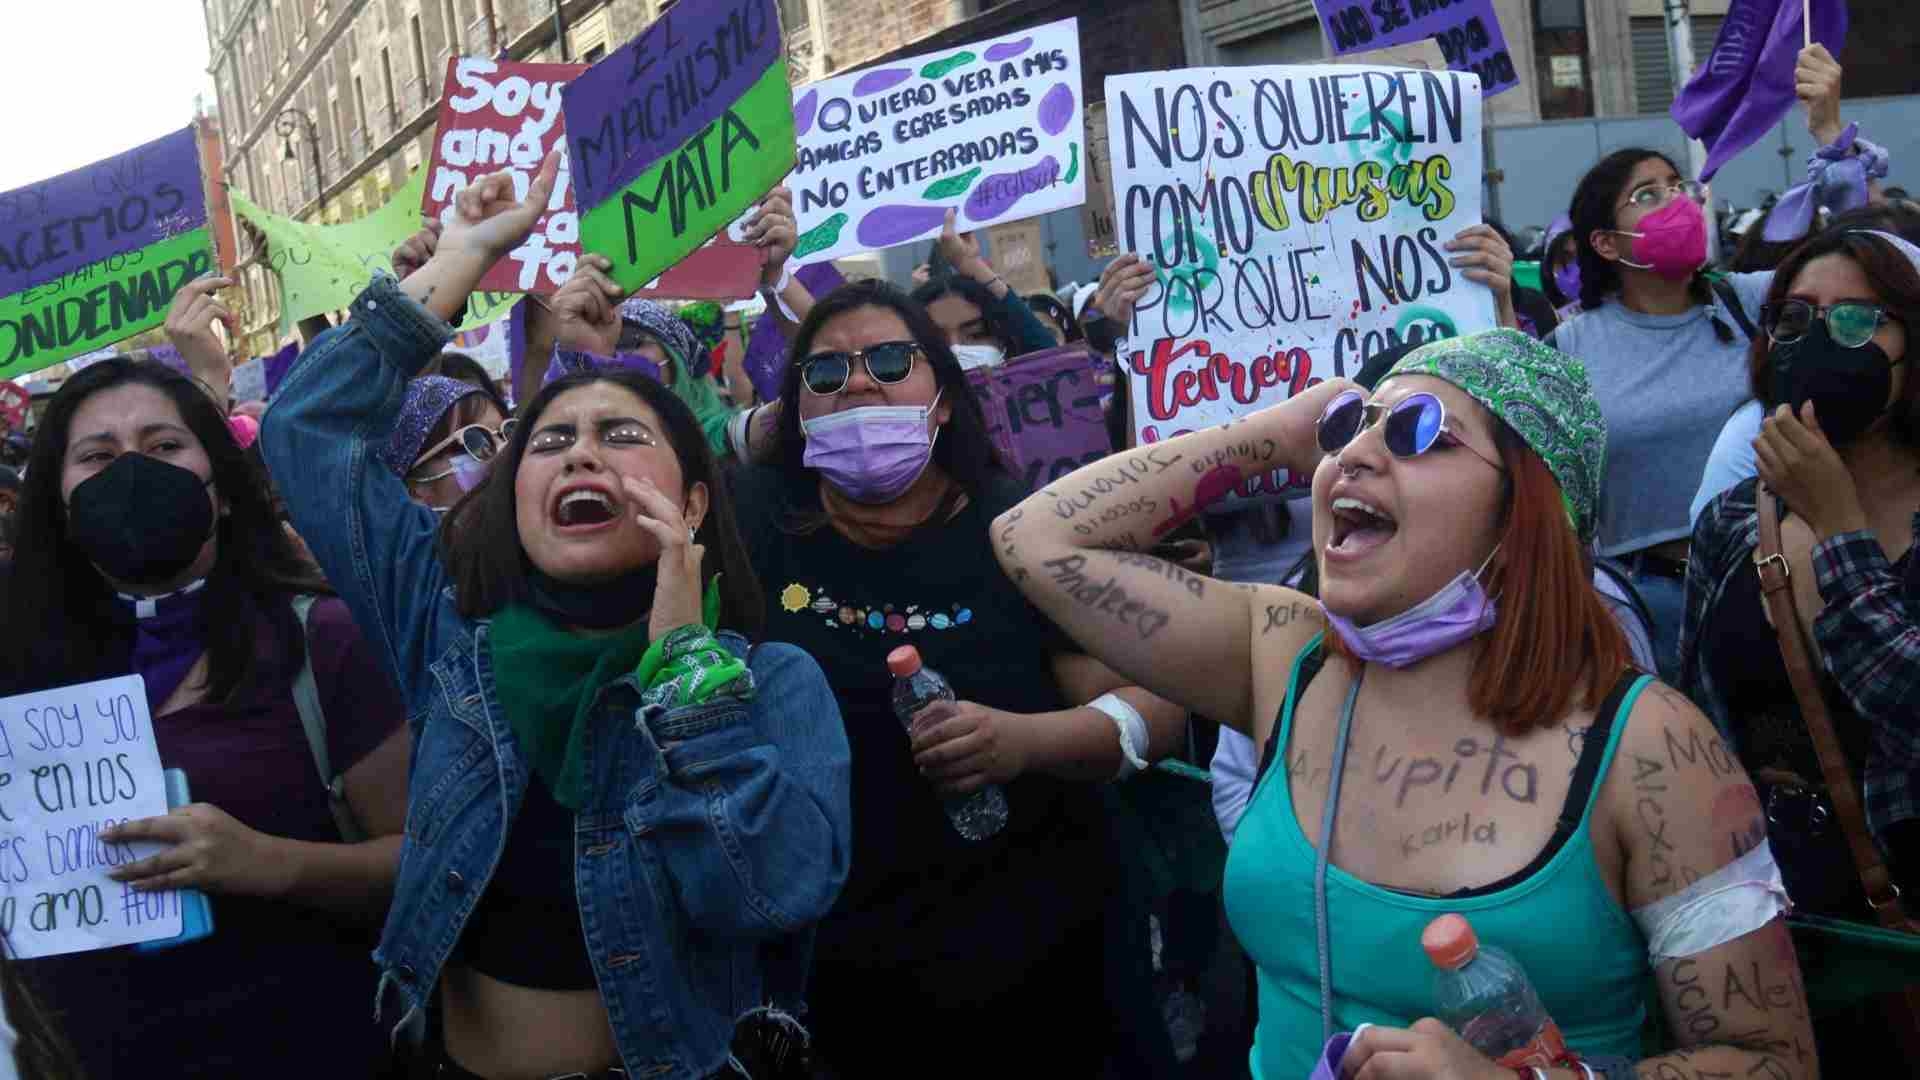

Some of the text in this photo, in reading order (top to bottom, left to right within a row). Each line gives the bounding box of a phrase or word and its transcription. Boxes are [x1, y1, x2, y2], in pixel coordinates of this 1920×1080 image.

[449, 56, 566, 132] Soy
[577, 0, 767, 189] MACHISMO
[794, 86, 1031, 174] AMIGAS EGRESADAS
[817, 48, 1069, 132] QUIERO VER A MIS
[1120, 79, 1245, 169] NOS
[1251, 70, 1463, 151] QUIEREN
[622, 108, 760, 266] MATA
[800, 177, 850, 214] NO
[859, 126, 1039, 199] ENTERRADAS
[1125, 174, 1255, 270] COMO
[20, 250, 145, 306] ESTAMOS
[1351, 226, 1453, 312] NOS
